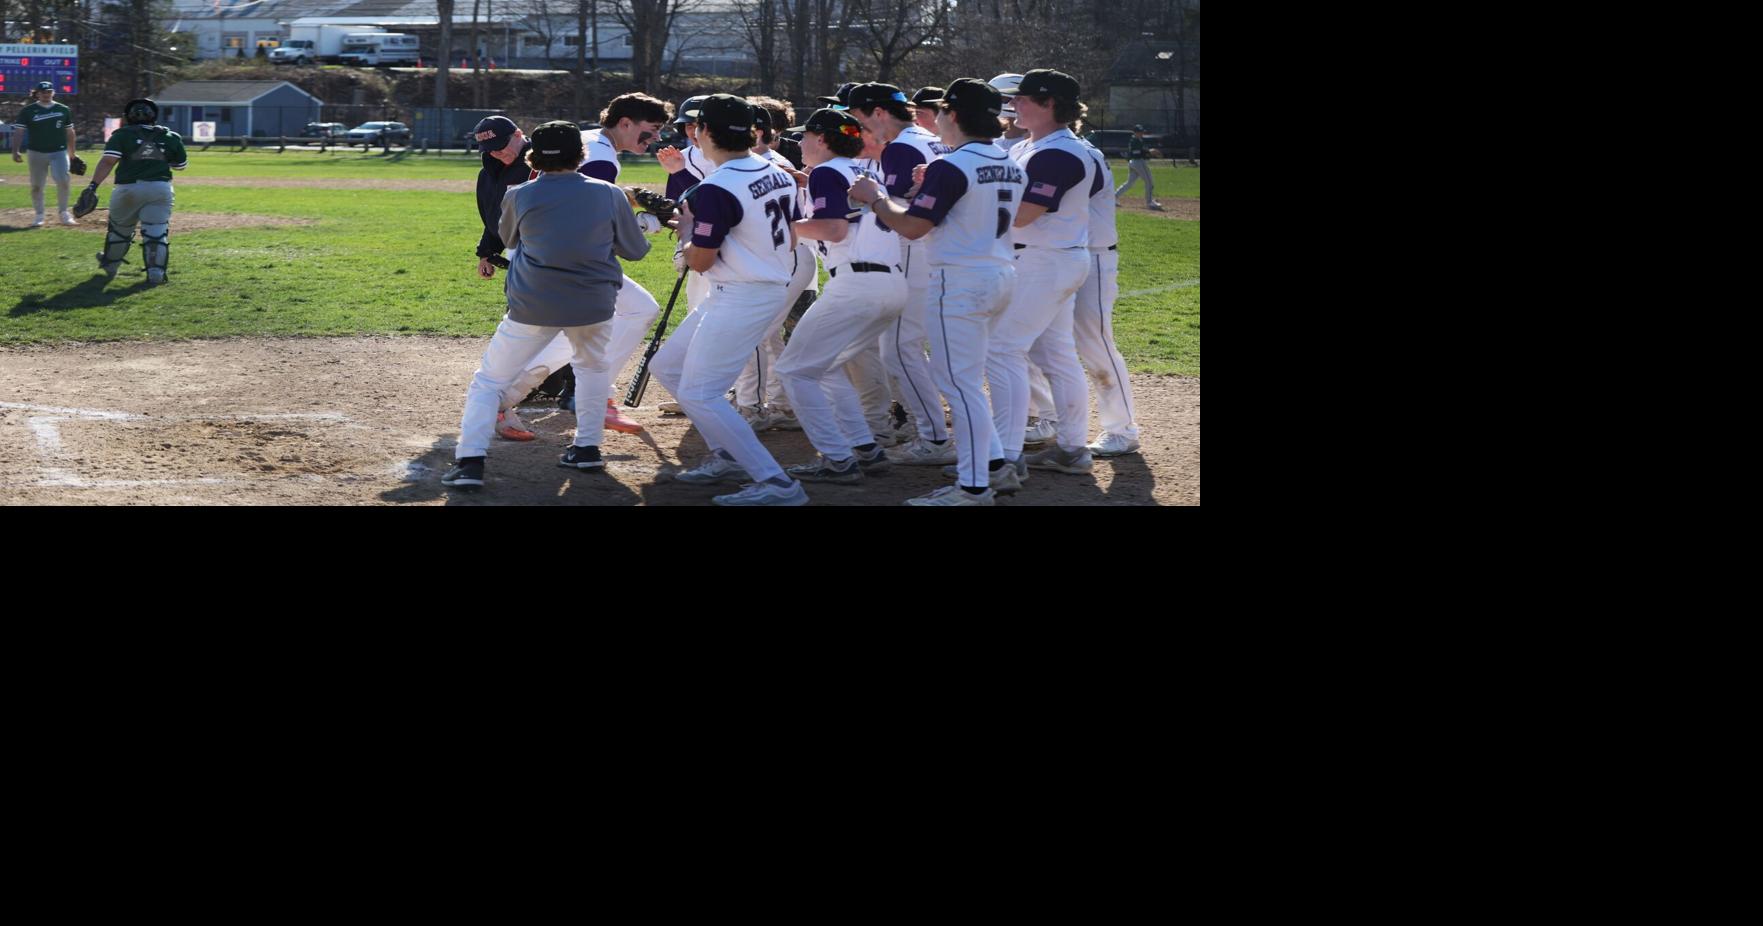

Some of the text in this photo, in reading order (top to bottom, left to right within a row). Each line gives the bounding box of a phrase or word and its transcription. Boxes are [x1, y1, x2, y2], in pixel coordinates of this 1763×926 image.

[6, 46, 47, 54] PELLERIN
[51, 47, 75, 55] FIELD
[996, 189, 1013, 239] 5
